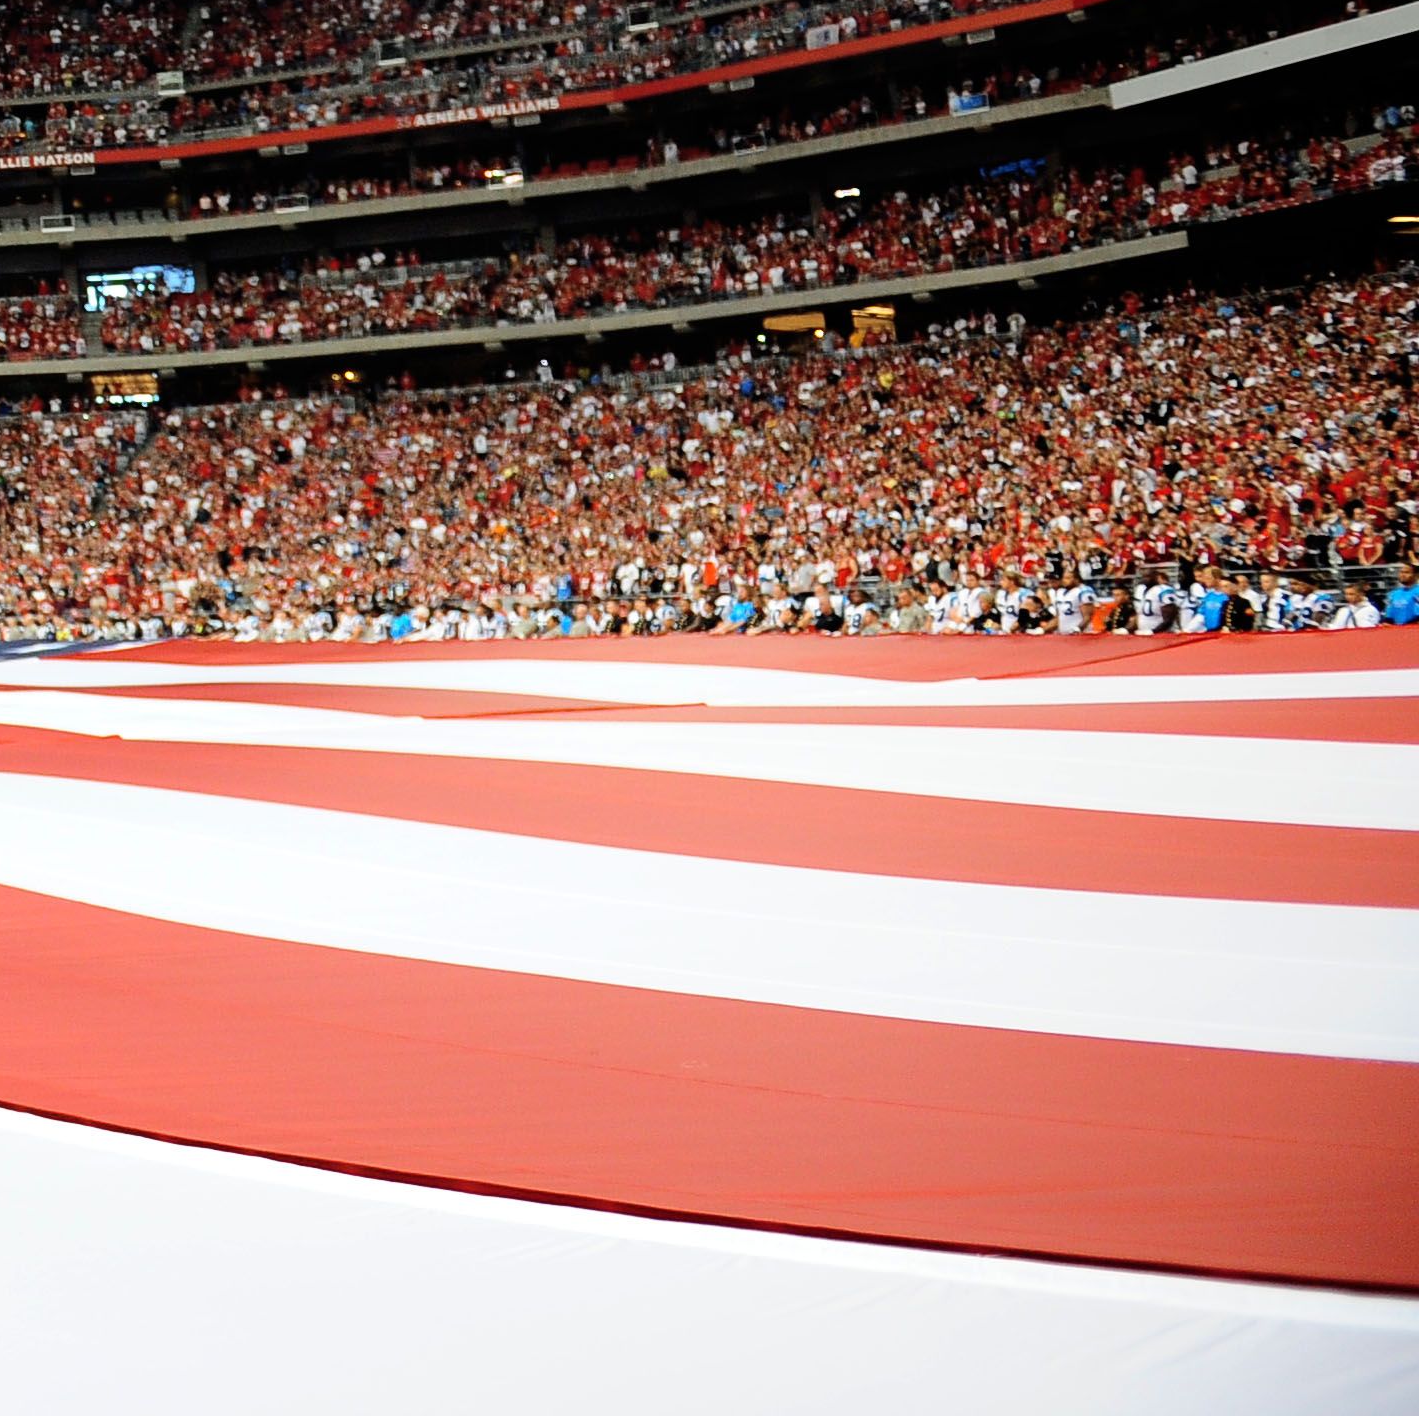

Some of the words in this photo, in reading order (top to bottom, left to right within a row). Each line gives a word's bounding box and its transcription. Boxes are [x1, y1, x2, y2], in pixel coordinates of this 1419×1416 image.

[414, 107, 478, 127] AENEAS
[481, 96, 560, 117] WILLIAMS
[33, 152, 95, 166] MATSON
